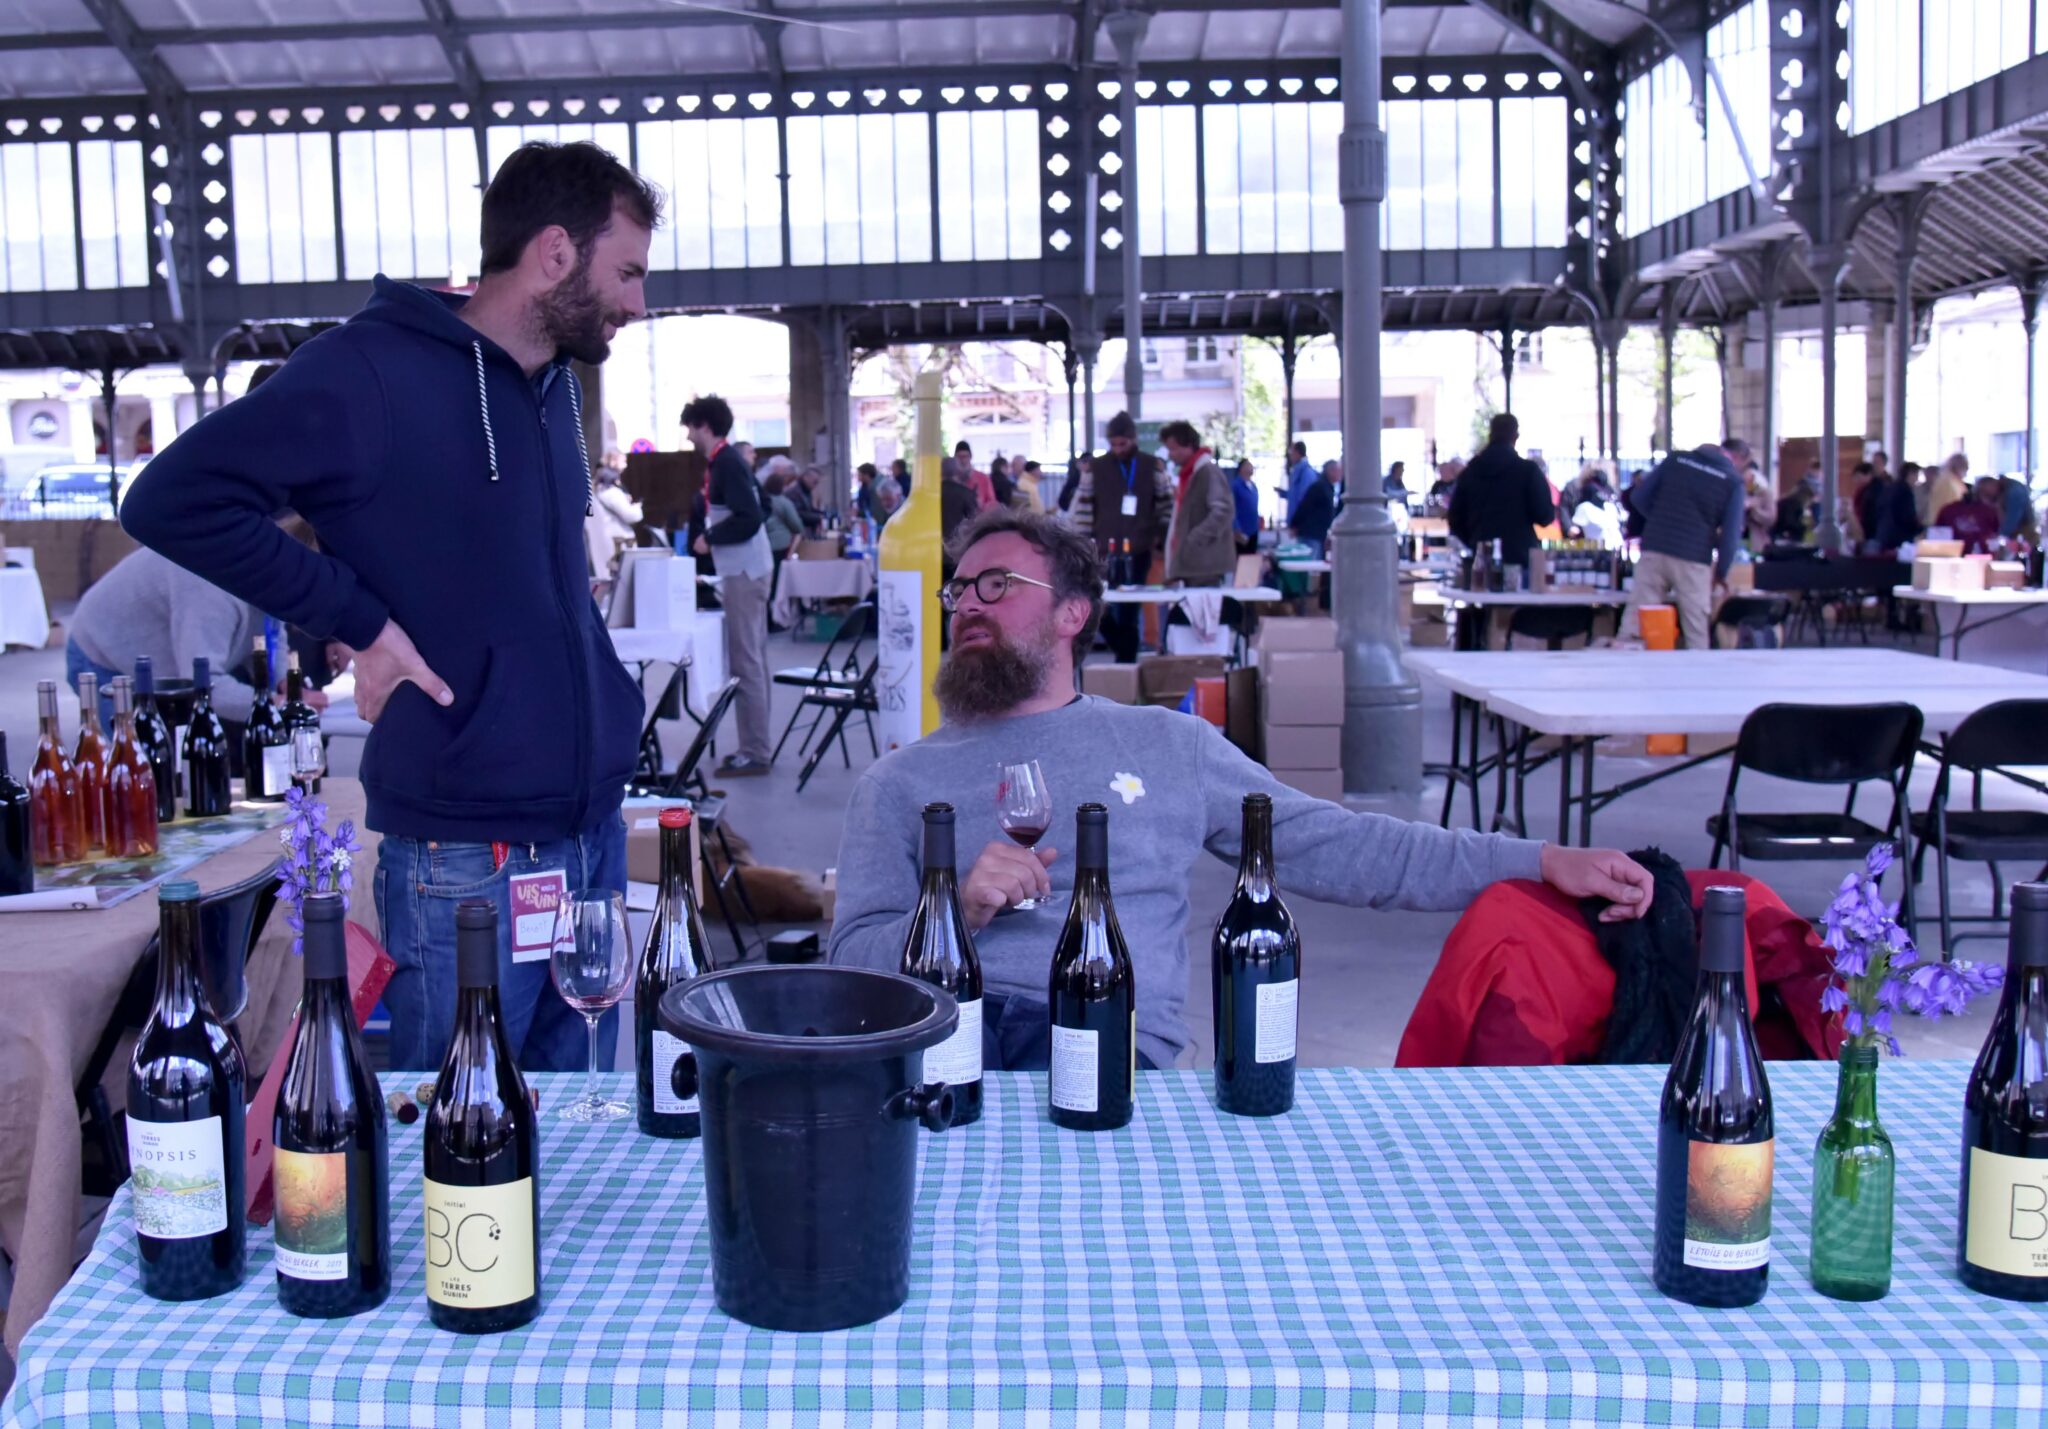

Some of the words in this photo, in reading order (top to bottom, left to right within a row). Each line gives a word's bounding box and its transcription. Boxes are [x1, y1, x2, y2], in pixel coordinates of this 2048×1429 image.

[132, 1146, 197, 1162] NOPSIS
[428, 1206, 499, 1273] BC
[441, 1280, 471, 1292] TERRES
